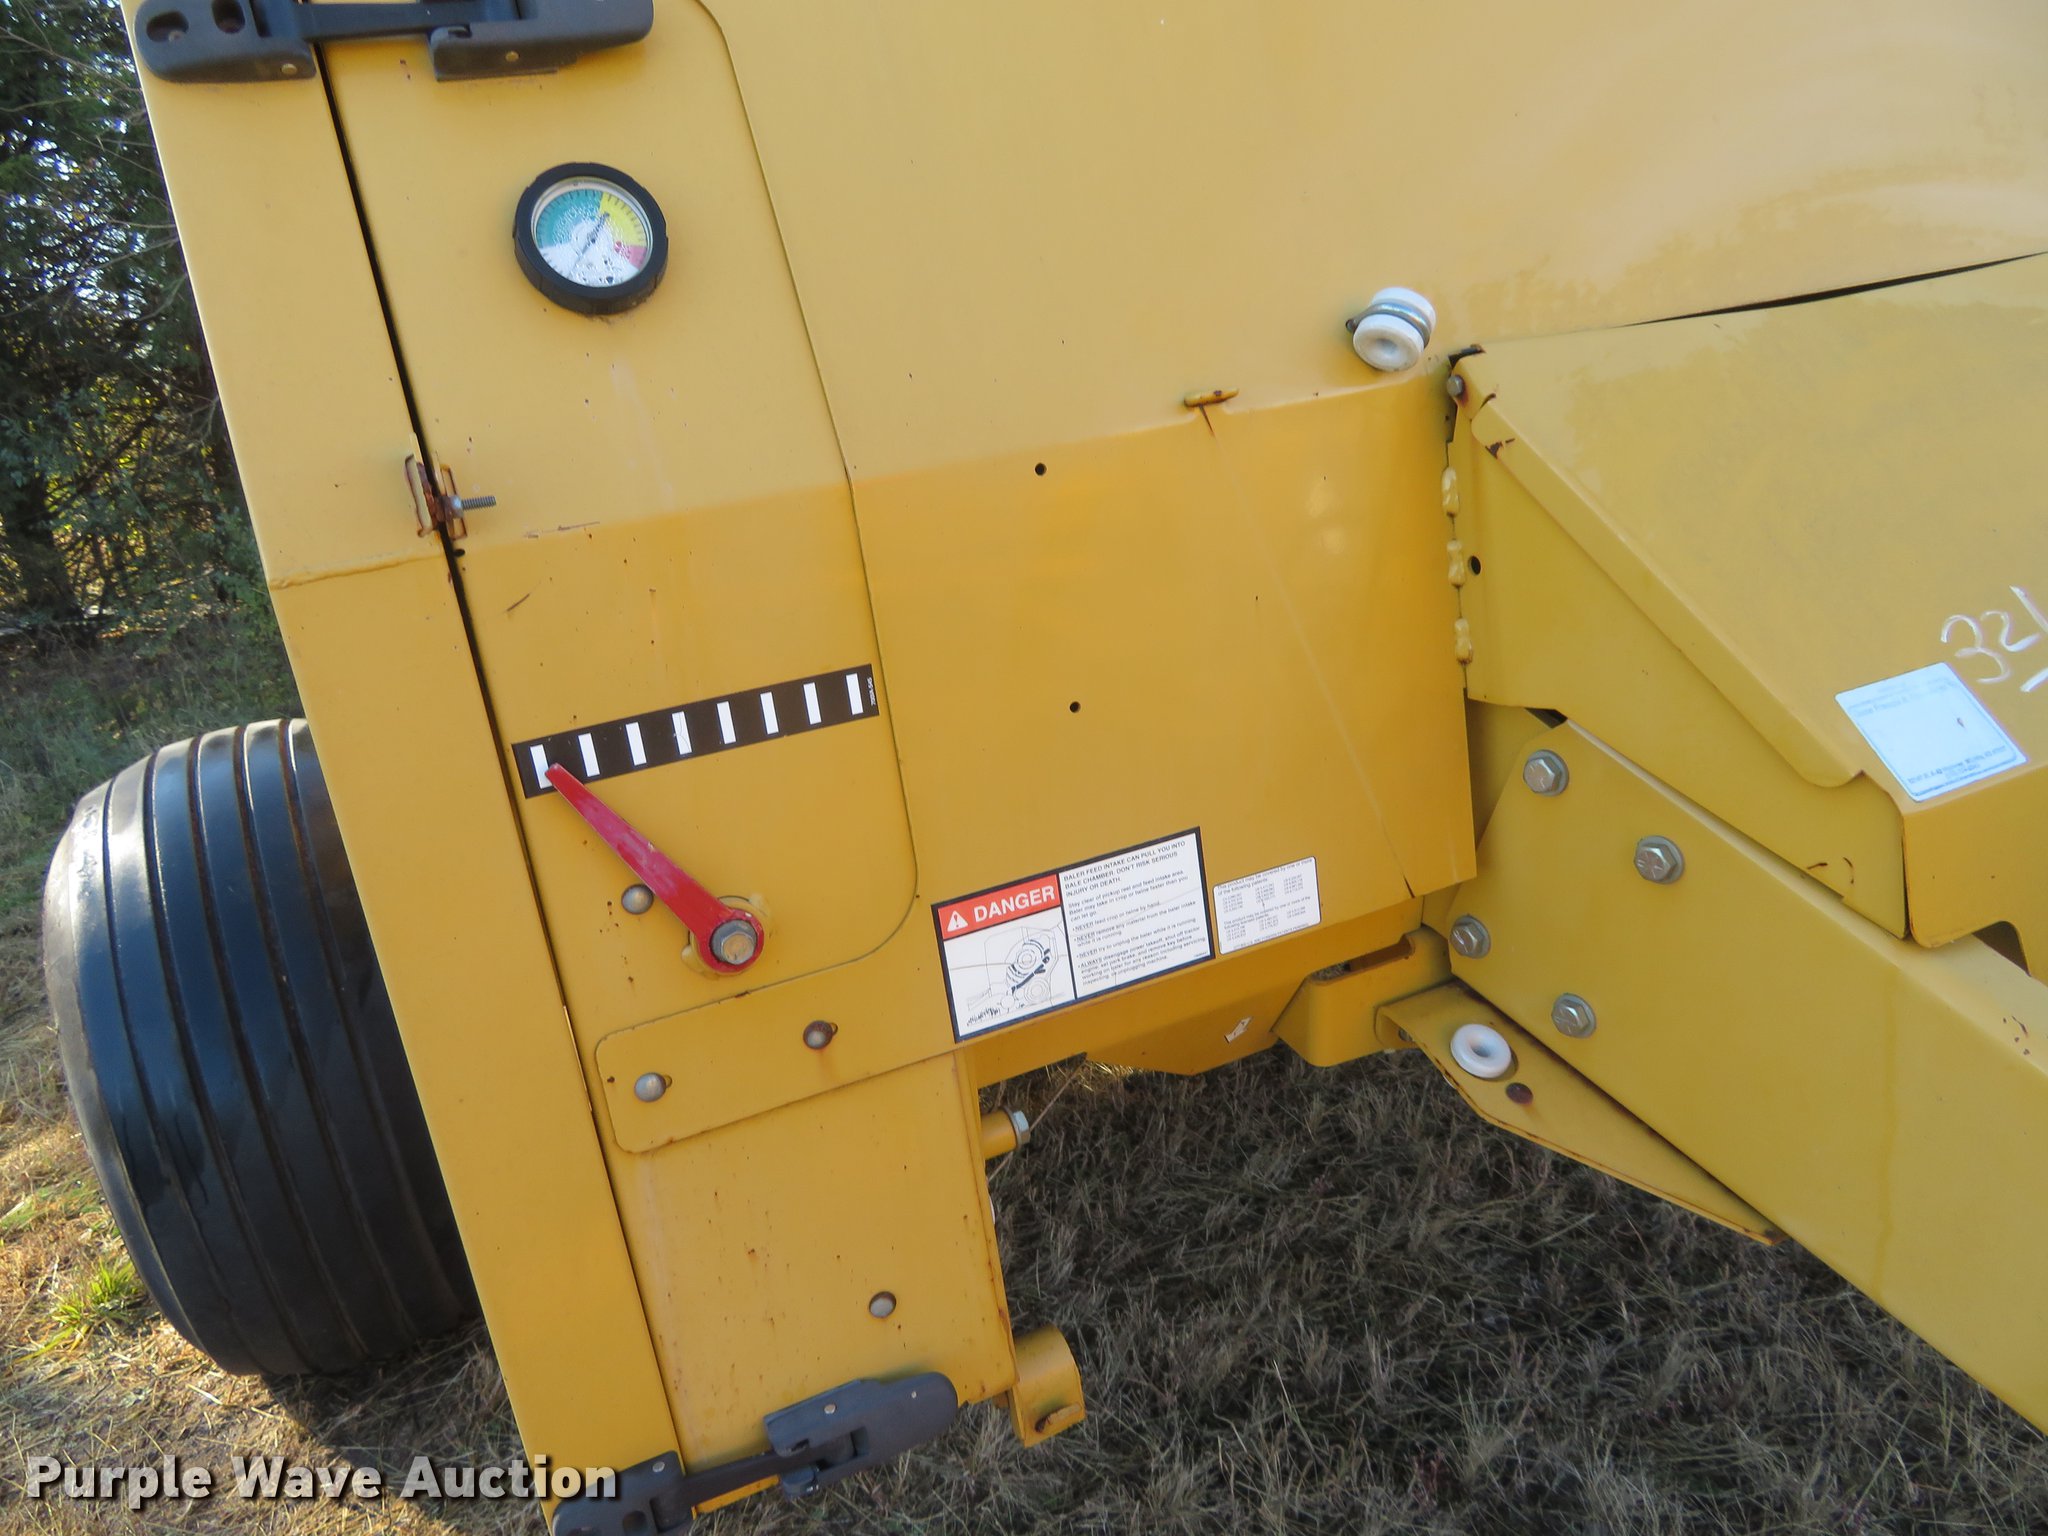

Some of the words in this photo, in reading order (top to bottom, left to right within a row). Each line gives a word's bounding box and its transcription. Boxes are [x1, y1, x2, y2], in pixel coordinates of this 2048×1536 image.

[1064, 871, 1085, 882] BALER
[1087, 866, 1102, 875] FEED
[1104, 859, 1124, 870] INTAKE
[1127, 854, 1140, 863] CAN
[1141, 849, 1156, 859] PULL
[1158, 845, 1171, 854] YOU
[1171, 840, 1186, 850] INTO
[1066, 880, 1082, 890] BALE
[1117, 864, 1134, 874] DON'T
[1136, 859, 1149, 868] RISK
[1152, 850, 1178, 863] SERIOUS
[1067, 886, 1089, 898] INJURY
[1090, 883, 1099, 891] OR
[1097, 899, 1108, 907] take
[1166, 878, 1177, 886] than
[973, 885, 1055, 922] DANGER
[1075, 922, 1094, 932] NEVER
[1077, 931, 1095, 942] NEVER
[1079, 948, 1098, 959] NEVER
[1081, 957, 1102, 968] ALWAYS
